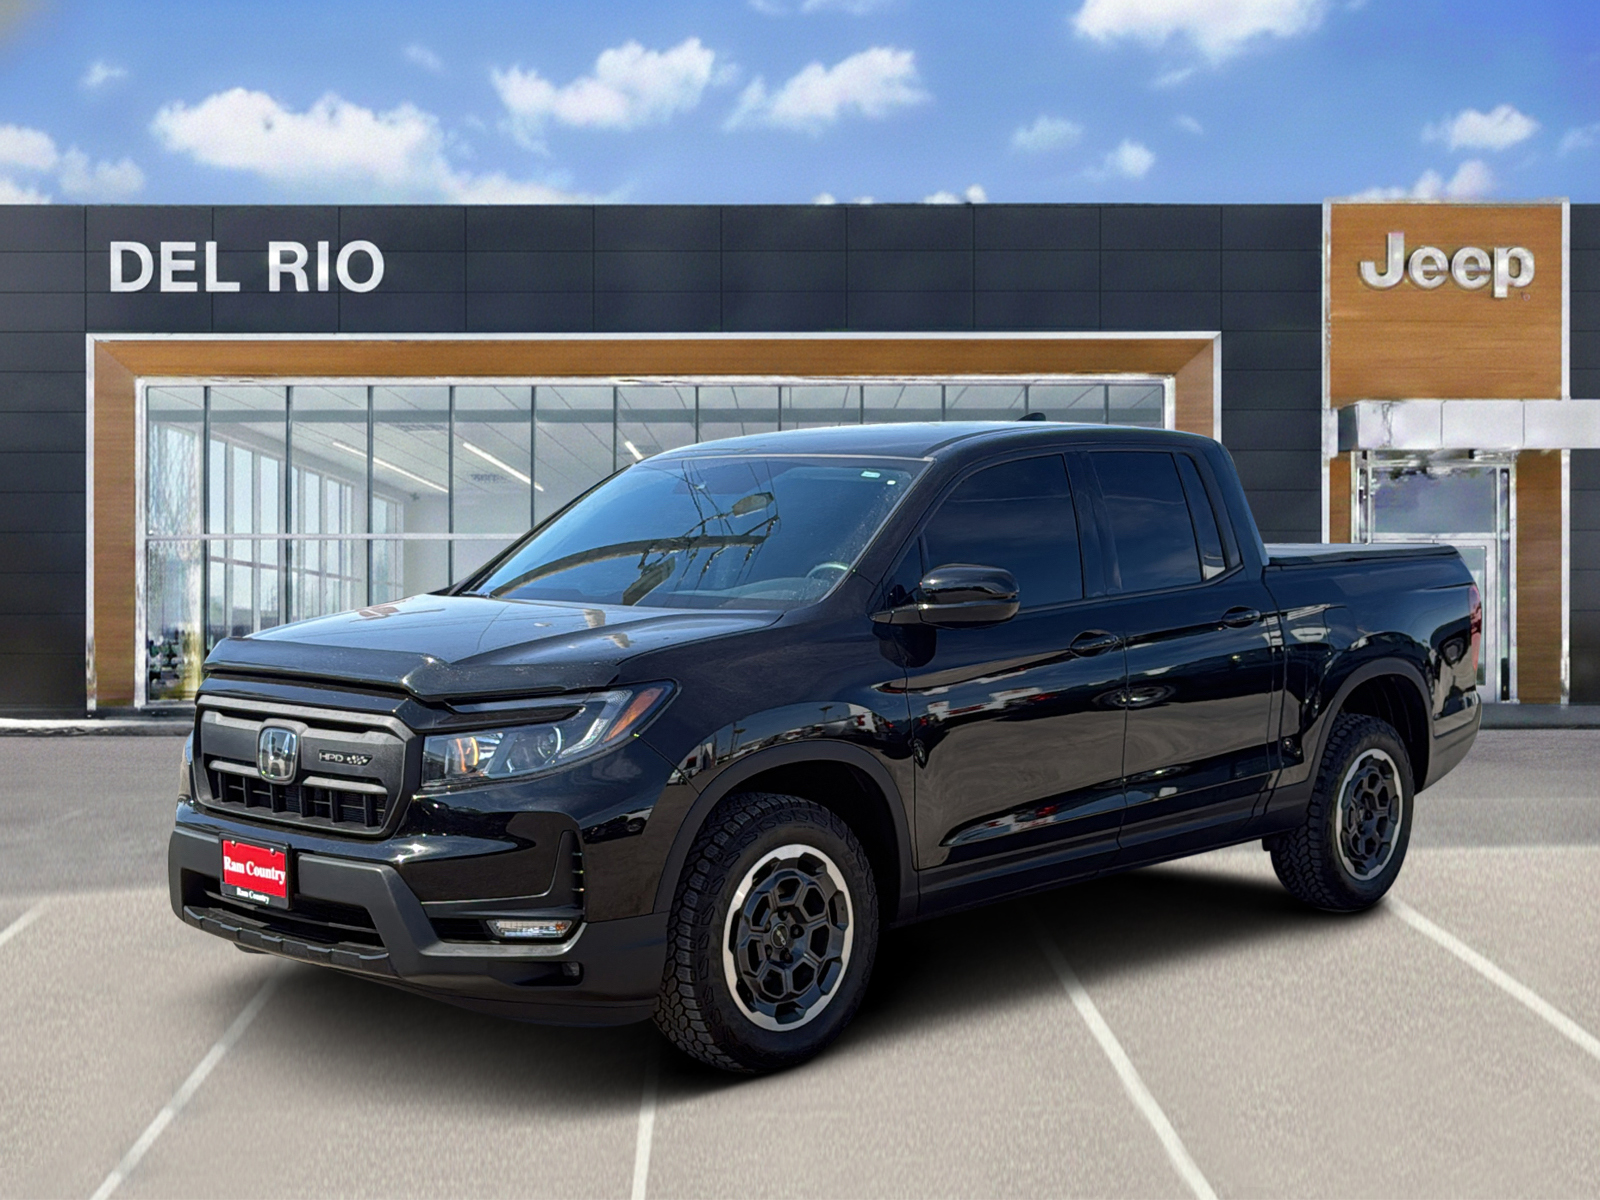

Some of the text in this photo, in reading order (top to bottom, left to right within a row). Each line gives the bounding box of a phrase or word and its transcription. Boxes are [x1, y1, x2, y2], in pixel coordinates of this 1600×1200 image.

[110, 240, 385, 293] DEL RIO
[1359, 231, 1535, 298] Jeep
[318, 752, 344, 762] HPD
[223, 856, 286, 885] Ram Country
[236, 887, 270, 905] Ram Country
